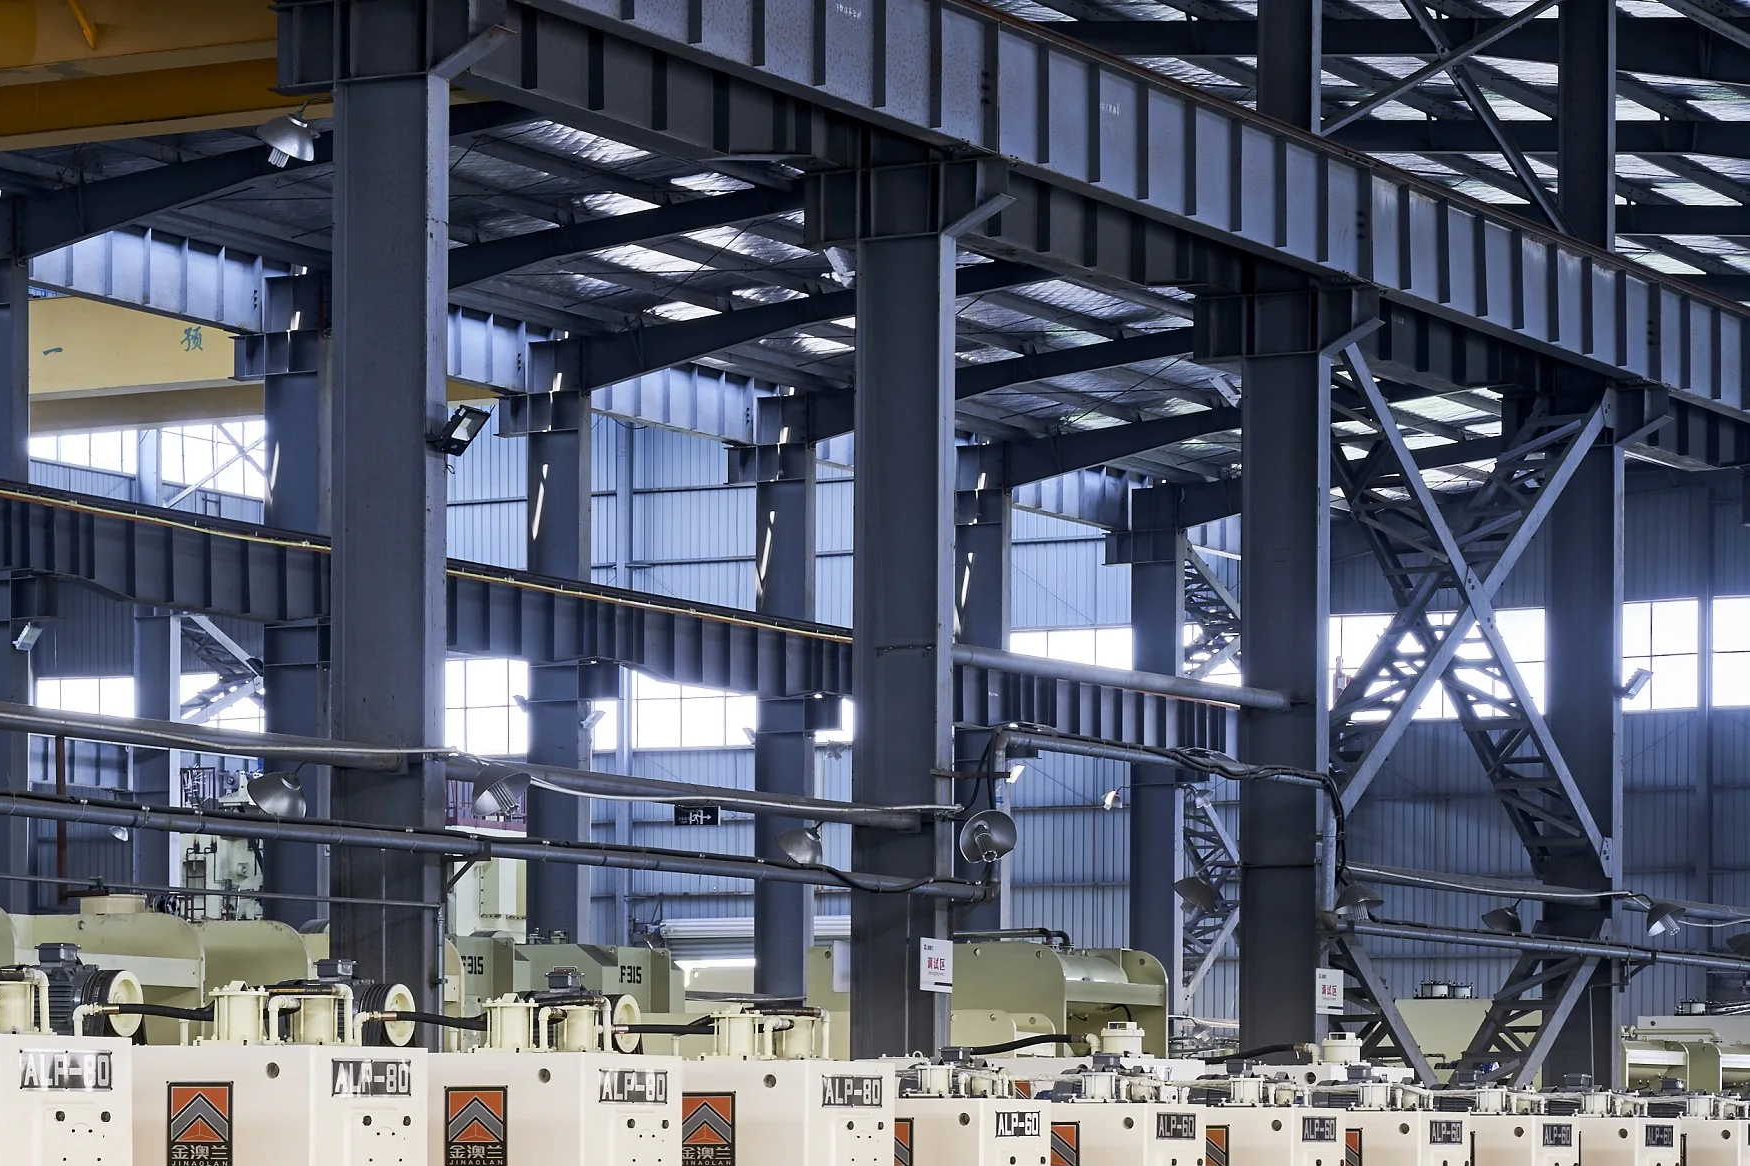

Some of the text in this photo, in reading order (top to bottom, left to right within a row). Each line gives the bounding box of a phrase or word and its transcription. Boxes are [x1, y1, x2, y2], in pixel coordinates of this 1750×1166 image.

[23, 1053, 110, 1087] ALP-80
[334, 1062, 408, 1093] ALP-80
[601, 1071, 666, 1101] ALP-80
[825, 1078, 881, 1105] ALP-80
[998, 1112, 1039, 1137] ALP-60
[1158, 1115, 1195, 1139] ALP-60
[1303, 1119, 1335, 1139] ALP-60
[1431, 1122, 1461, 1142] ALP-60
[1544, 1126, 1571, 1145] ALP-60
[1647, 1127, 1672, 1145] ALP-60
[171, 1144, 228, 1160] 金澳兰
[449, 1144, 503, 1159] 金澳兰
[682, 1146, 732, 1160] 金澳兰
